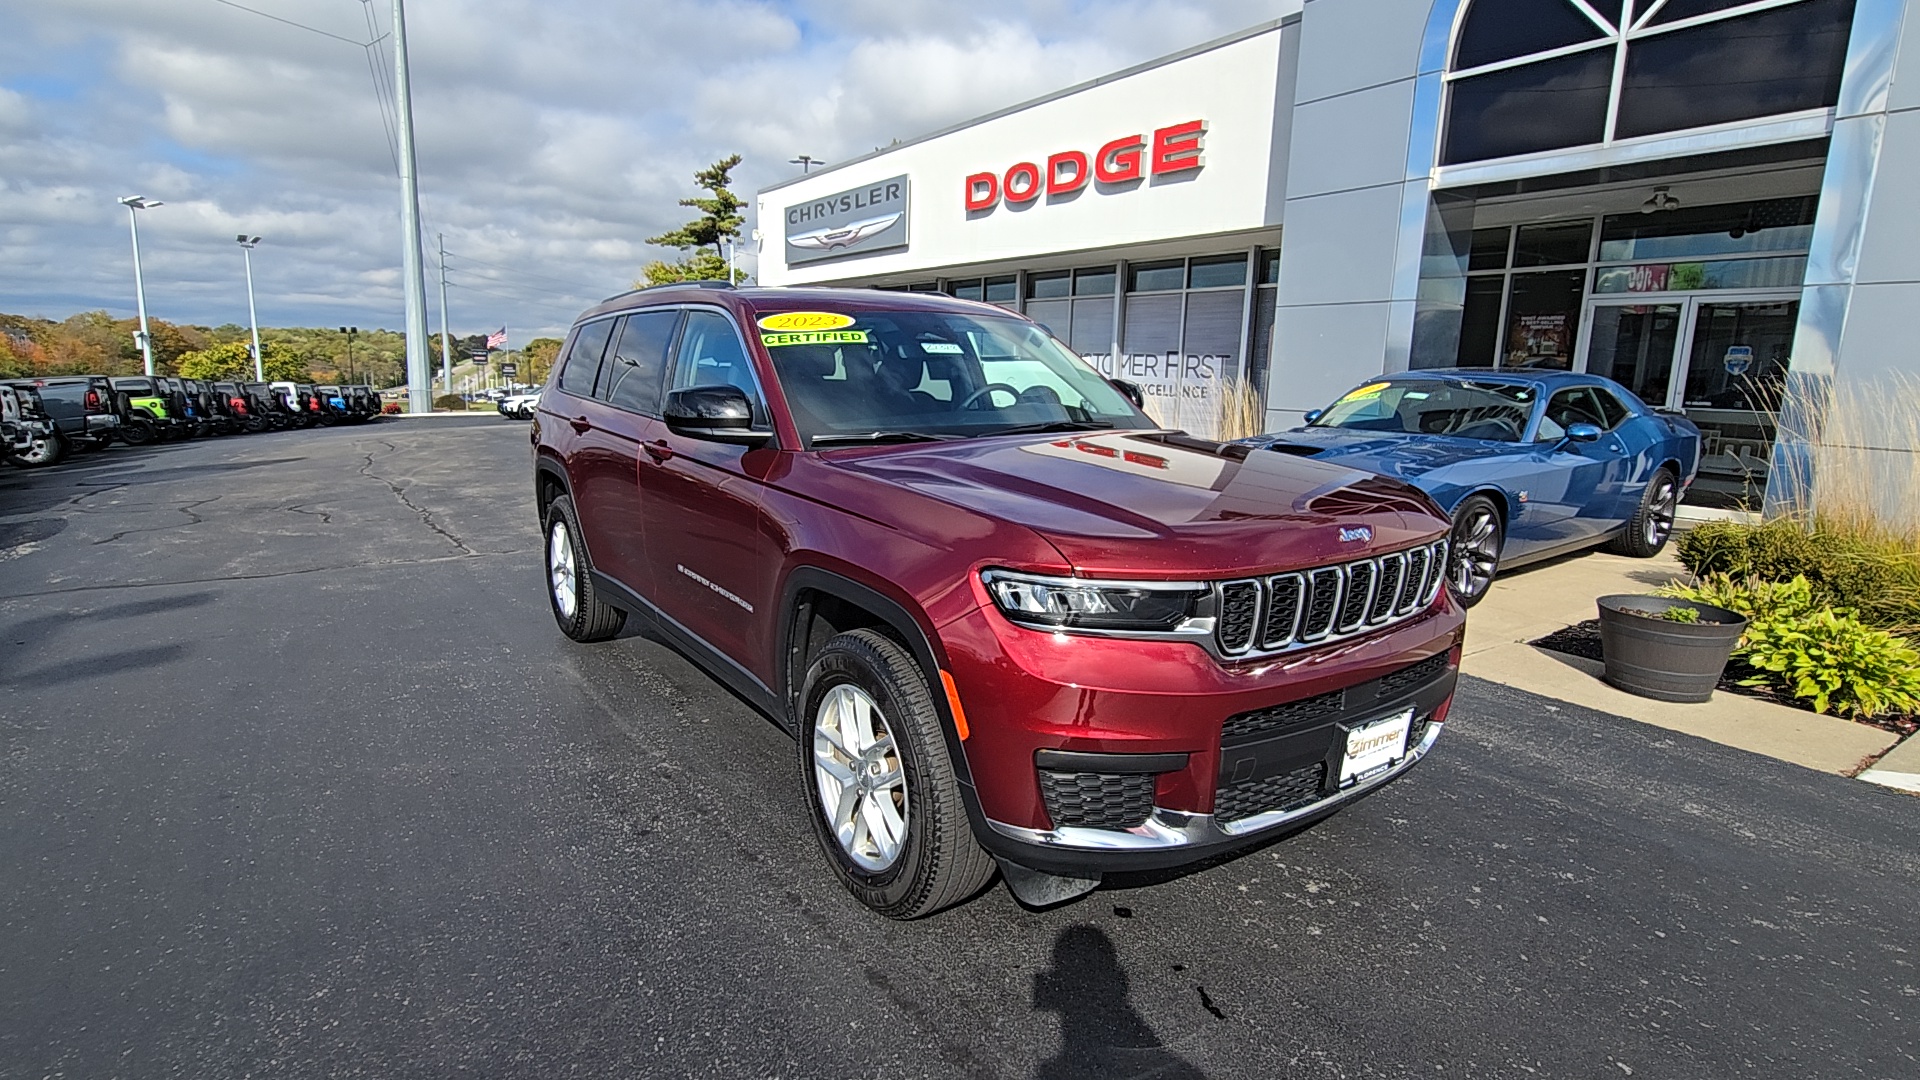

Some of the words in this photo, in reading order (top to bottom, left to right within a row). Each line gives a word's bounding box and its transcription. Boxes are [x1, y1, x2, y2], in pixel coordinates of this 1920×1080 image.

[965, 119, 1206, 212] DODGE
[787, 182, 901, 226] CHRYSLER
[777, 316, 838, 328] 2023
[764, 332, 862, 345] CERTIFIED
[1339, 527, 1372, 543] Jeep
[1357, 764, 1389, 781] FLORENCE
